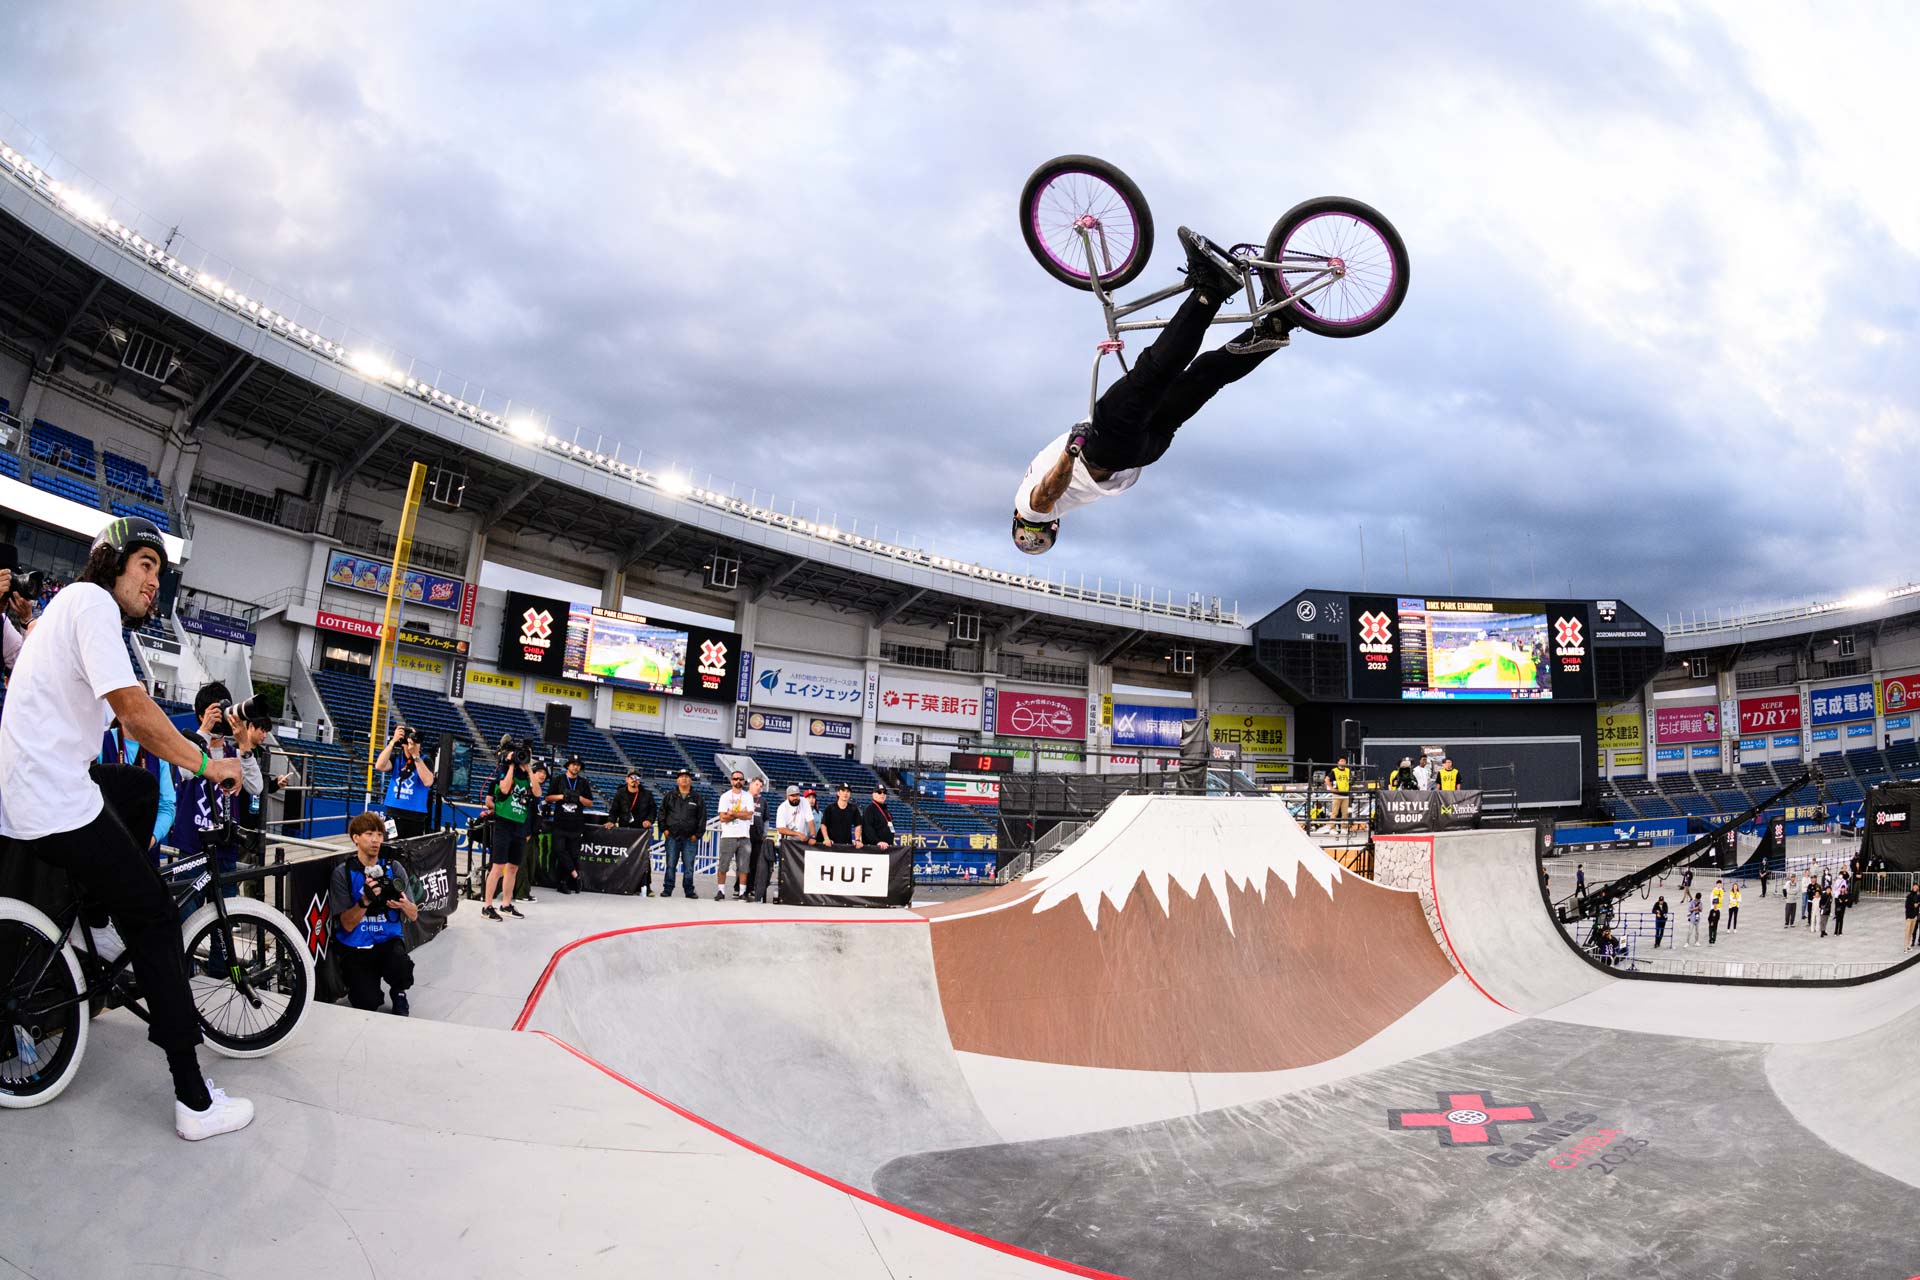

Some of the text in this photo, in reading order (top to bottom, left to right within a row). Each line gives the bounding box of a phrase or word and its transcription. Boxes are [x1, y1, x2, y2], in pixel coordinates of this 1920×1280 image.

[1426, 601, 1493, 611] BMX PARK ELIMINATION
[320, 616, 372, 634] LOTTERIA
[230, 631, 245, 640] SADA
[519, 635, 551, 648] GAMES
[523, 646, 545, 656] CHIBA
[1359, 642, 1394, 654] GAMES
[1556, 646, 1585, 656] GAMES
[524, 653, 543, 662] 2023
[1365, 653, 1389, 662] CHIBA
[698, 665, 726, 677] GAMES
[1367, 662, 1387, 670] 2023
[1563, 664, 1580, 672] 2023
[702, 675, 721, 684] CHIBA
[702, 681, 719, 690] 2023
[784, 682, 861, 702] エイジェック
[901, 692, 979, 716] 千葉銀行
[1761, 702, 1783, 710] SUPER
[1813, 691, 1872, 716] 京成電鉄
[694, 707, 718, 715] VEOLIA
[1659, 720, 1702, 735] ちば興銀
[1213, 728, 1283, 744] 新日本建設
[978, 756, 991, 770] 13
[1387, 801, 1429, 812] INSTYLE
[1395, 813, 1423, 823] GROUP
[1886, 813, 1906, 822] GAMES
[580, 843, 629, 858] NSTER
[580, 855, 618, 863] NERGY
[172, 856, 208, 874] mongoose
[820, 865, 873, 883] HUF
[193, 871, 212, 891] VANS
[361, 913, 387, 923] AMES
[361, 924, 384, 932] CHIBA
[1486, 1111, 1598, 1168] GAMES
[1549, 1128, 1625, 1169] CHIBA
[1588, 1137, 1650, 1175] 2023
